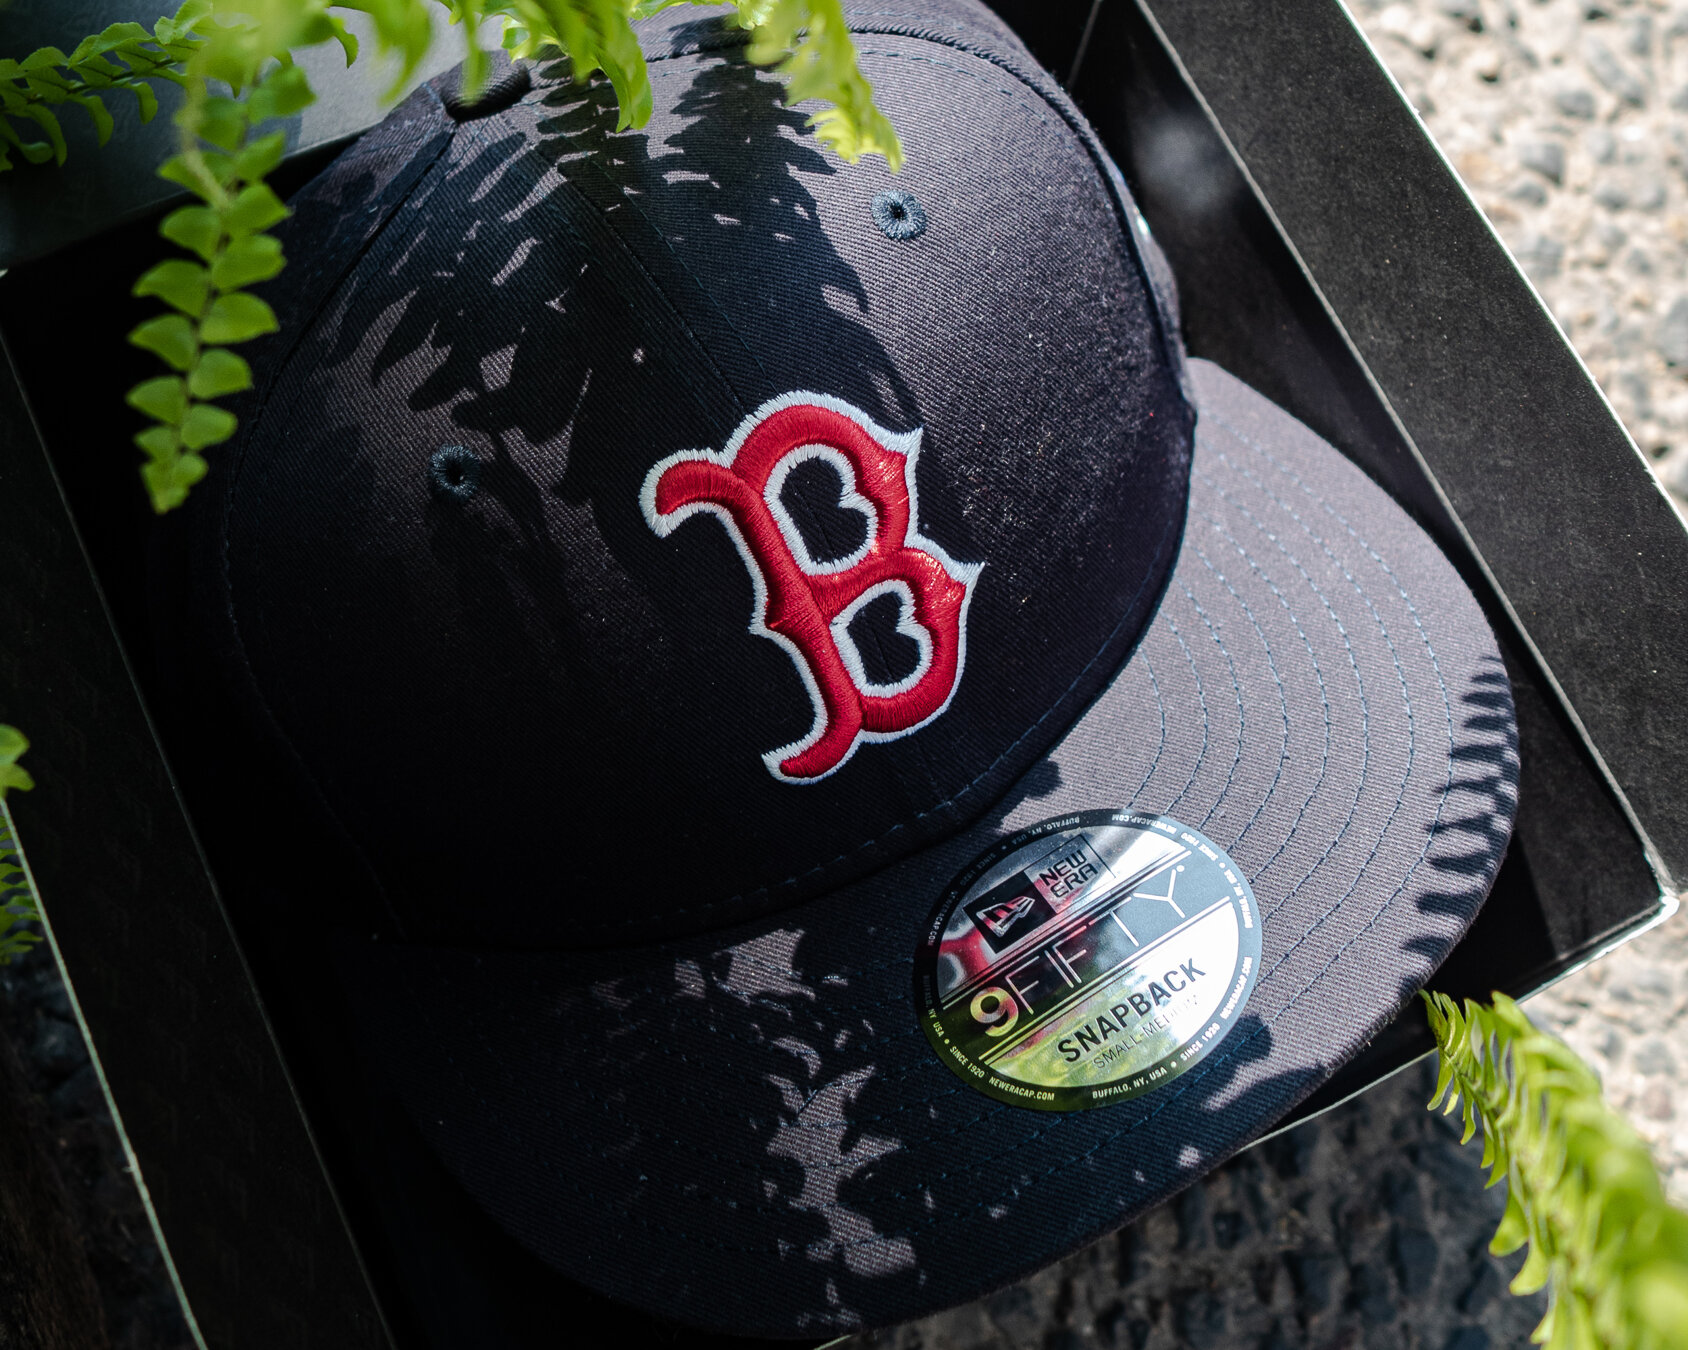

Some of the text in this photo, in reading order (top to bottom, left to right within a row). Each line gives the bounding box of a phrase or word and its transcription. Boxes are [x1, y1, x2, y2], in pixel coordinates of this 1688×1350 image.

[638, 390, 985, 785] B
[1039, 850, 1086, 886] NEW
[1050, 863, 1098, 897] ERA
[1057, 958, 1206, 1062] SNAPBACK
[933, 1021, 945, 1037] USA
[949, 1045, 969, 1065] SINCE
[967, 1062, 985, 1078] 1920
[988, 1076, 1055, 1101] NEWERACAP.COM
[1149, 1067, 1168, 1080] USA
[1180, 1040, 1203, 1061] SINCE
[1202, 1022, 1220, 1042] 1920
